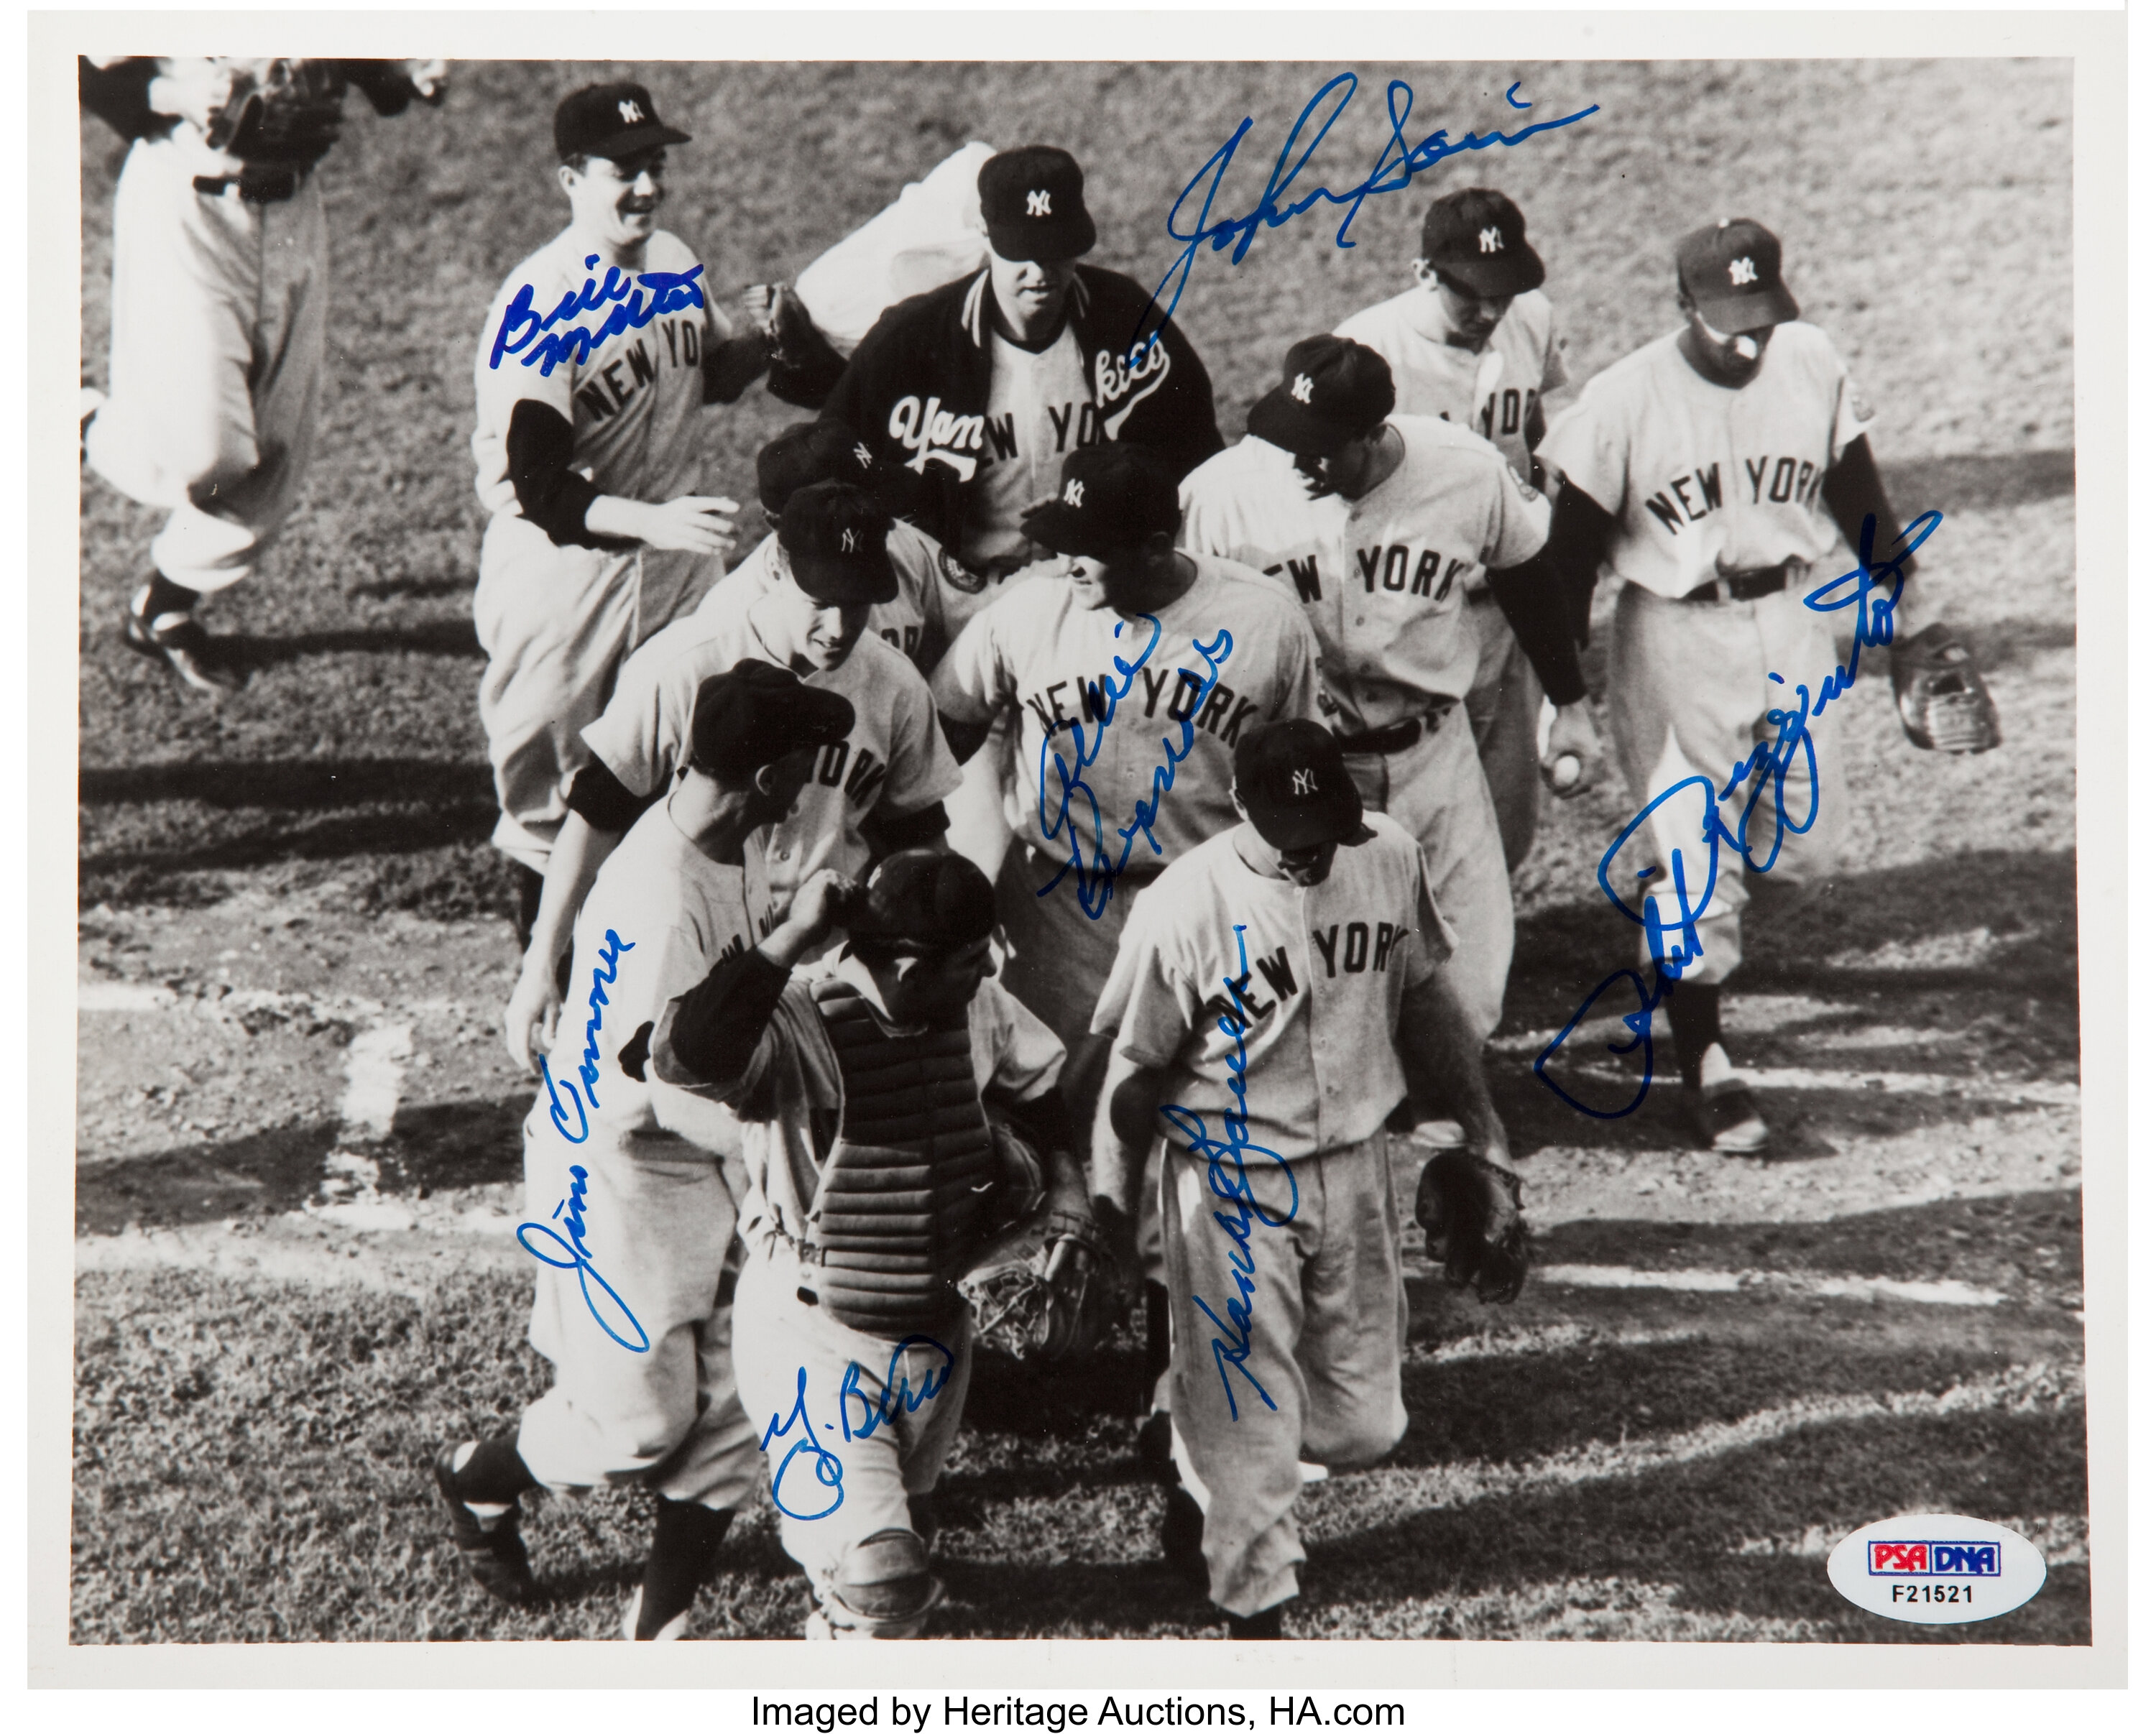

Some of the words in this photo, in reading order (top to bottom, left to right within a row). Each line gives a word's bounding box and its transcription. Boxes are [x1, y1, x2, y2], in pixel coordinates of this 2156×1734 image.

[576, 338, 655, 422] NEW
[661, 318, 702, 368] YO
[1645, 462, 1723, 535] NEW
[1356, 545, 1465, 604] YORK
[1026, 673, 1107, 737] NEW
[1143, 667, 1258, 748] YORK
[1207, 946, 1299, 1029] NEW
[1874, 1544, 1927, 1572] PSA
[1934, 1546, 1996, 1573] DNA
[1892, 1585, 1972, 1603] F21521
